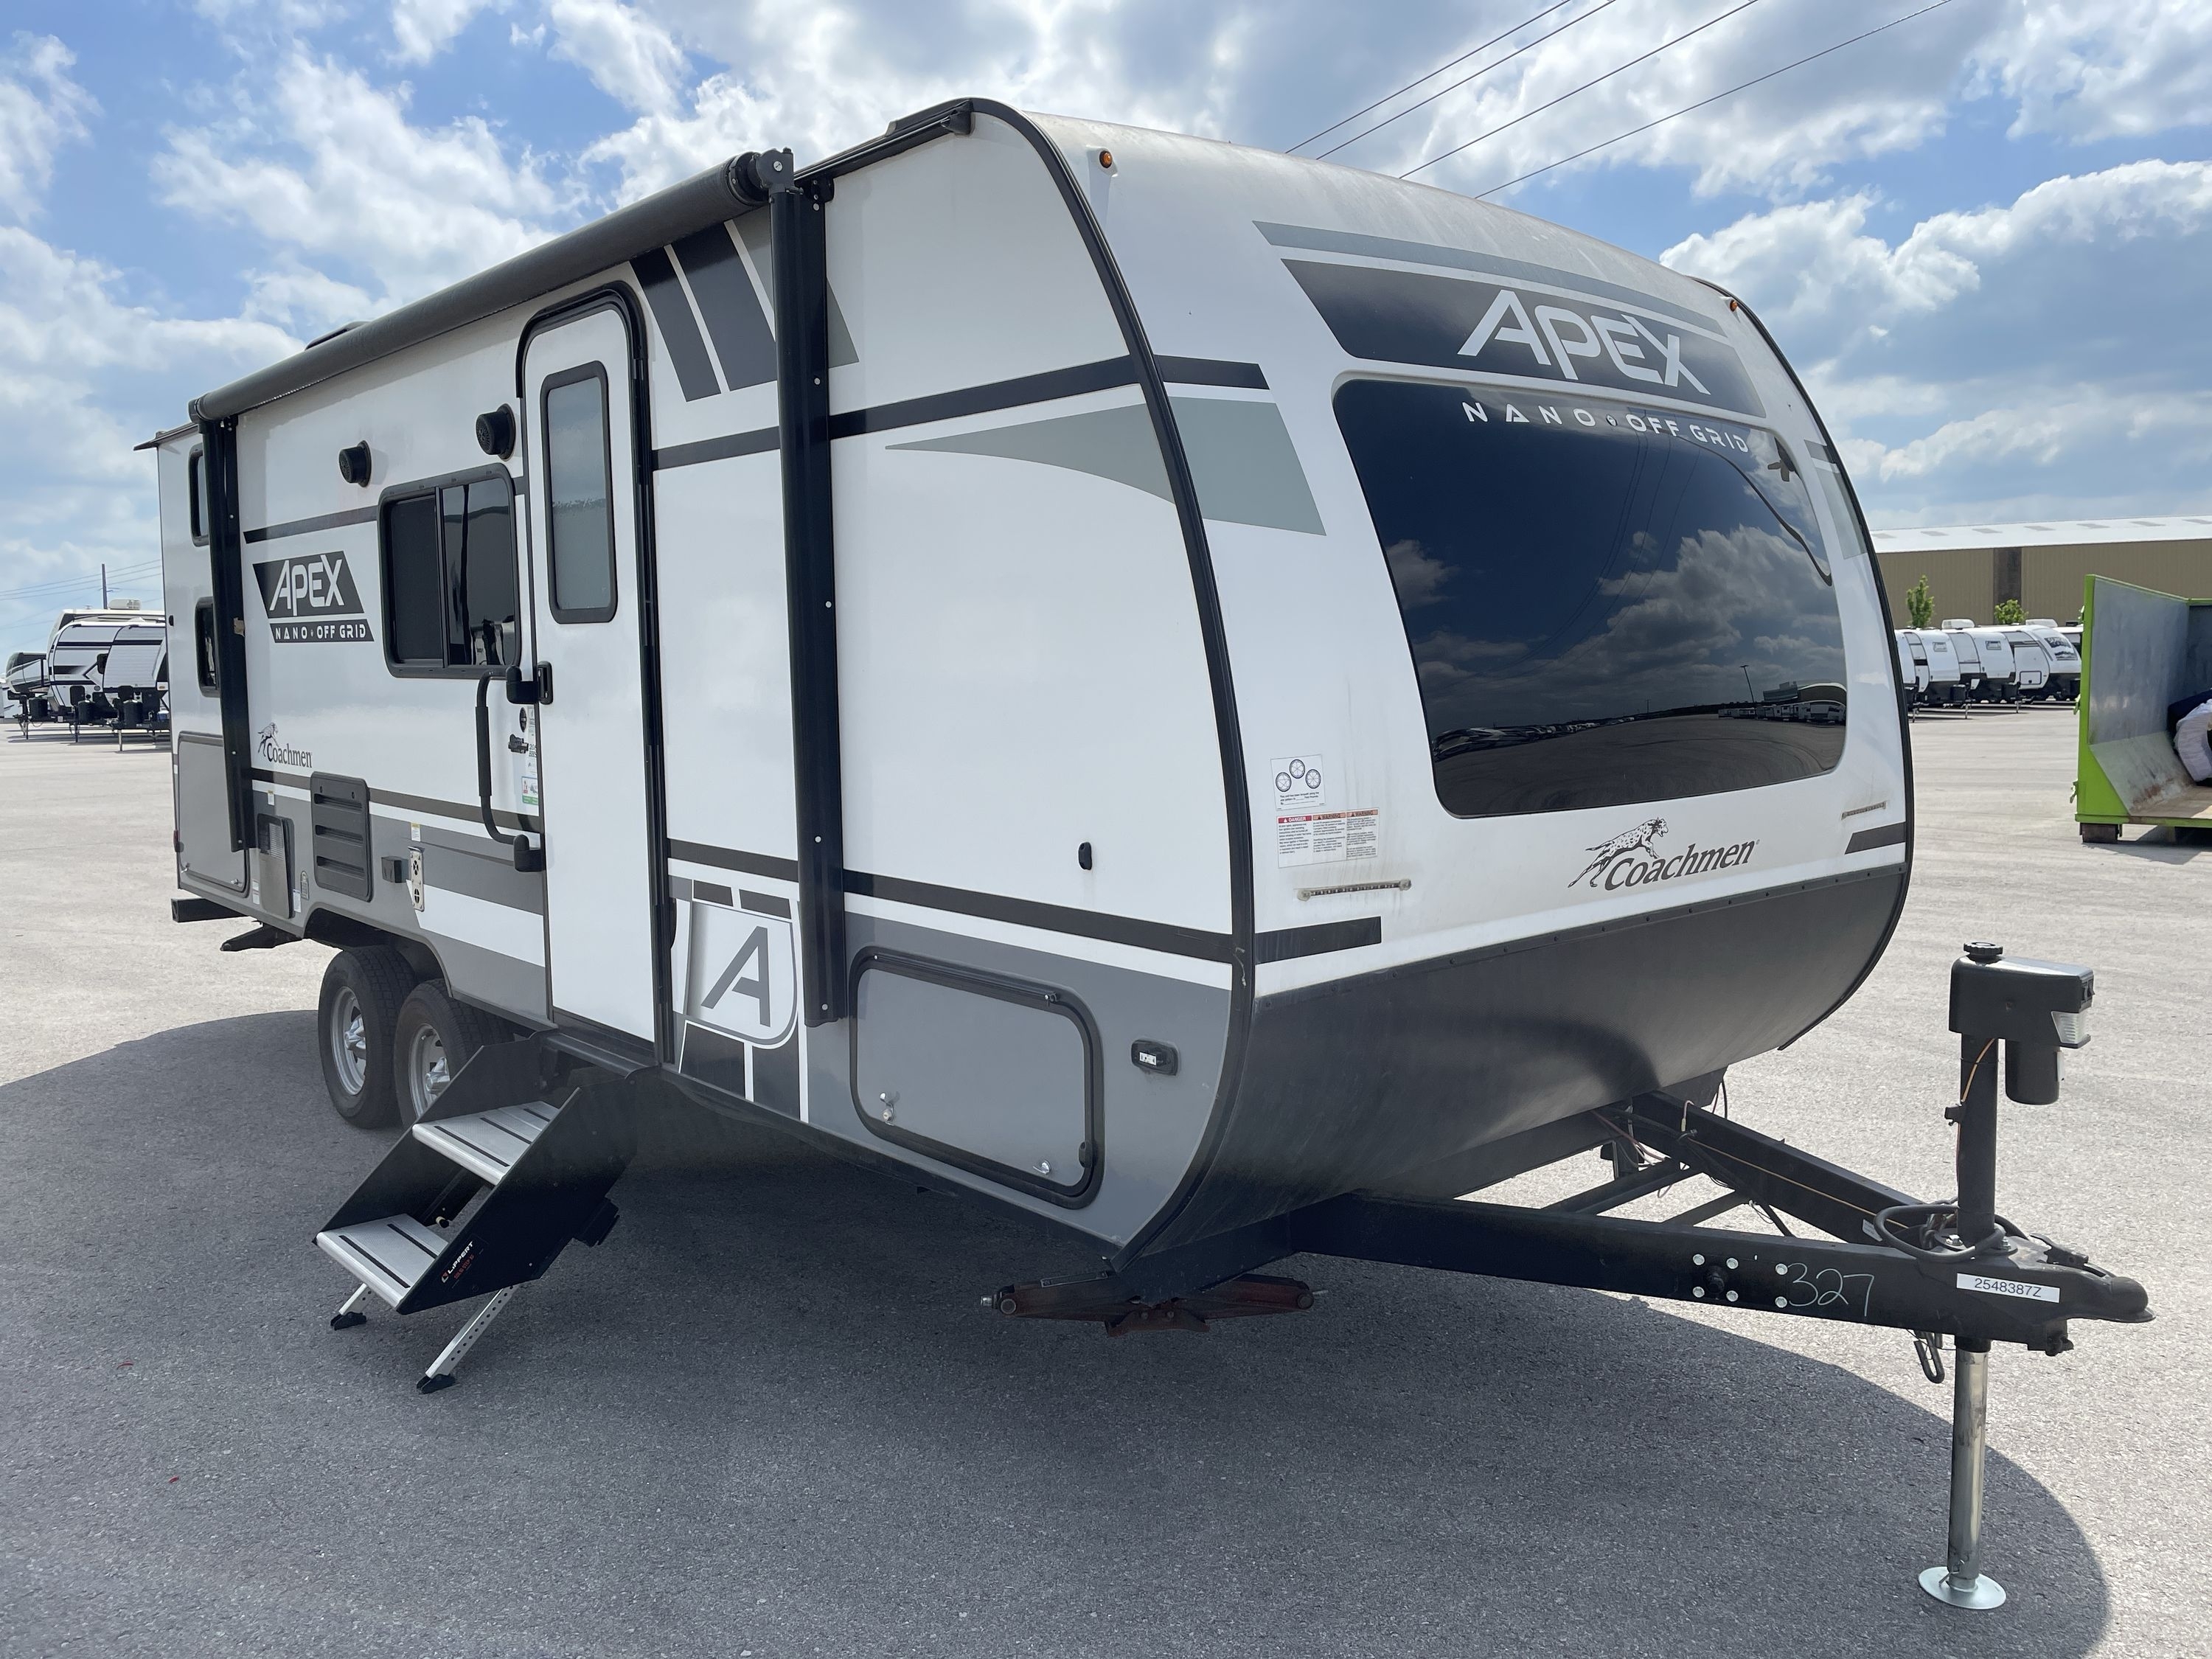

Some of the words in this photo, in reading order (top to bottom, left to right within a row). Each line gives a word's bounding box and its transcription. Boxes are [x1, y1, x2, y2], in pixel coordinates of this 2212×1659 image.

[1457, 289, 1711, 395] APEX
[1462, 402, 1596, 427] NANO
[1626, 414, 1680, 437] OFF
[1689, 424, 1748, 453] GRID
[269, 554, 344, 616] APEX
[275, 626, 307, 640] NANO
[316, 625, 335, 639] OFF
[339, 624, 366, 639] GRID
[267, 743, 313, 768] Coachmen
[1604, 841, 1756, 891] Coachmen
[700, 926, 771, 1028] A
[1787, 1262, 1875, 1318] 327
[1973, 1277, 2042, 1298] 2548387Z
